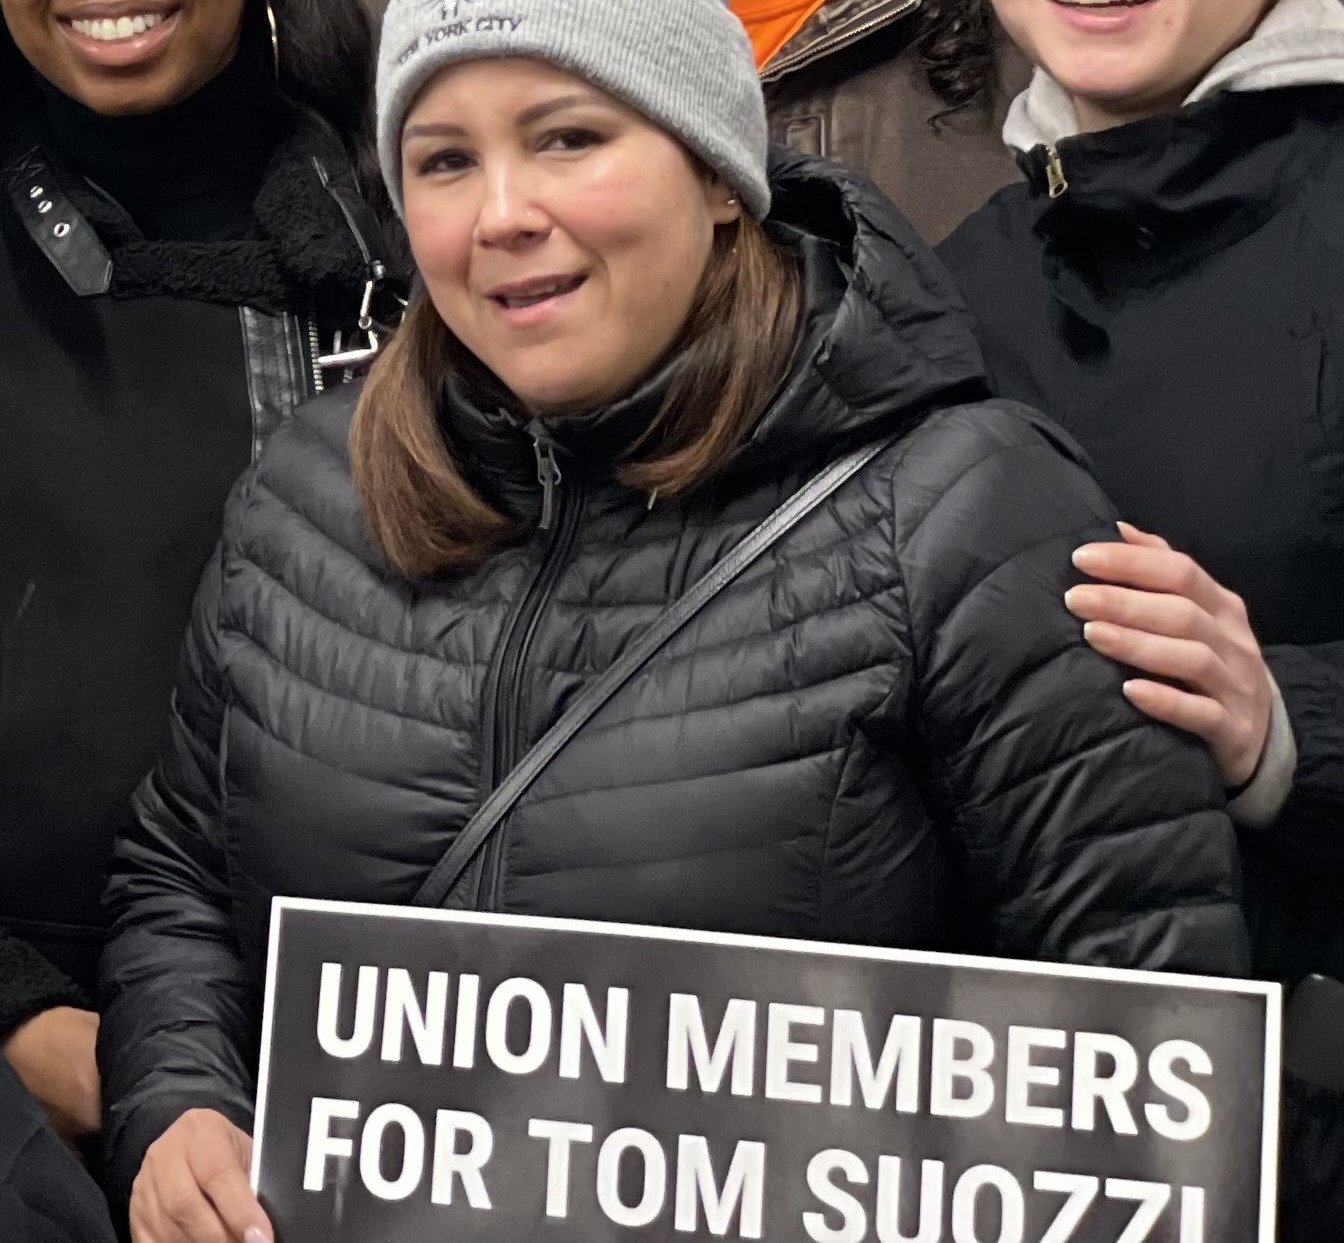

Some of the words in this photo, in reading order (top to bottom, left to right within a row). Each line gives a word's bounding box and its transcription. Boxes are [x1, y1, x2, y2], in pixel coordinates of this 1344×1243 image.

[315, 962, 630, 1084] UNION
[665, 992, 1214, 1142] MEMBERS
[302, 1096, 494, 1210] FOR
[527, 1118, 766, 1239] TOM
[801, 1147, 1205, 1243] SUOZZI
